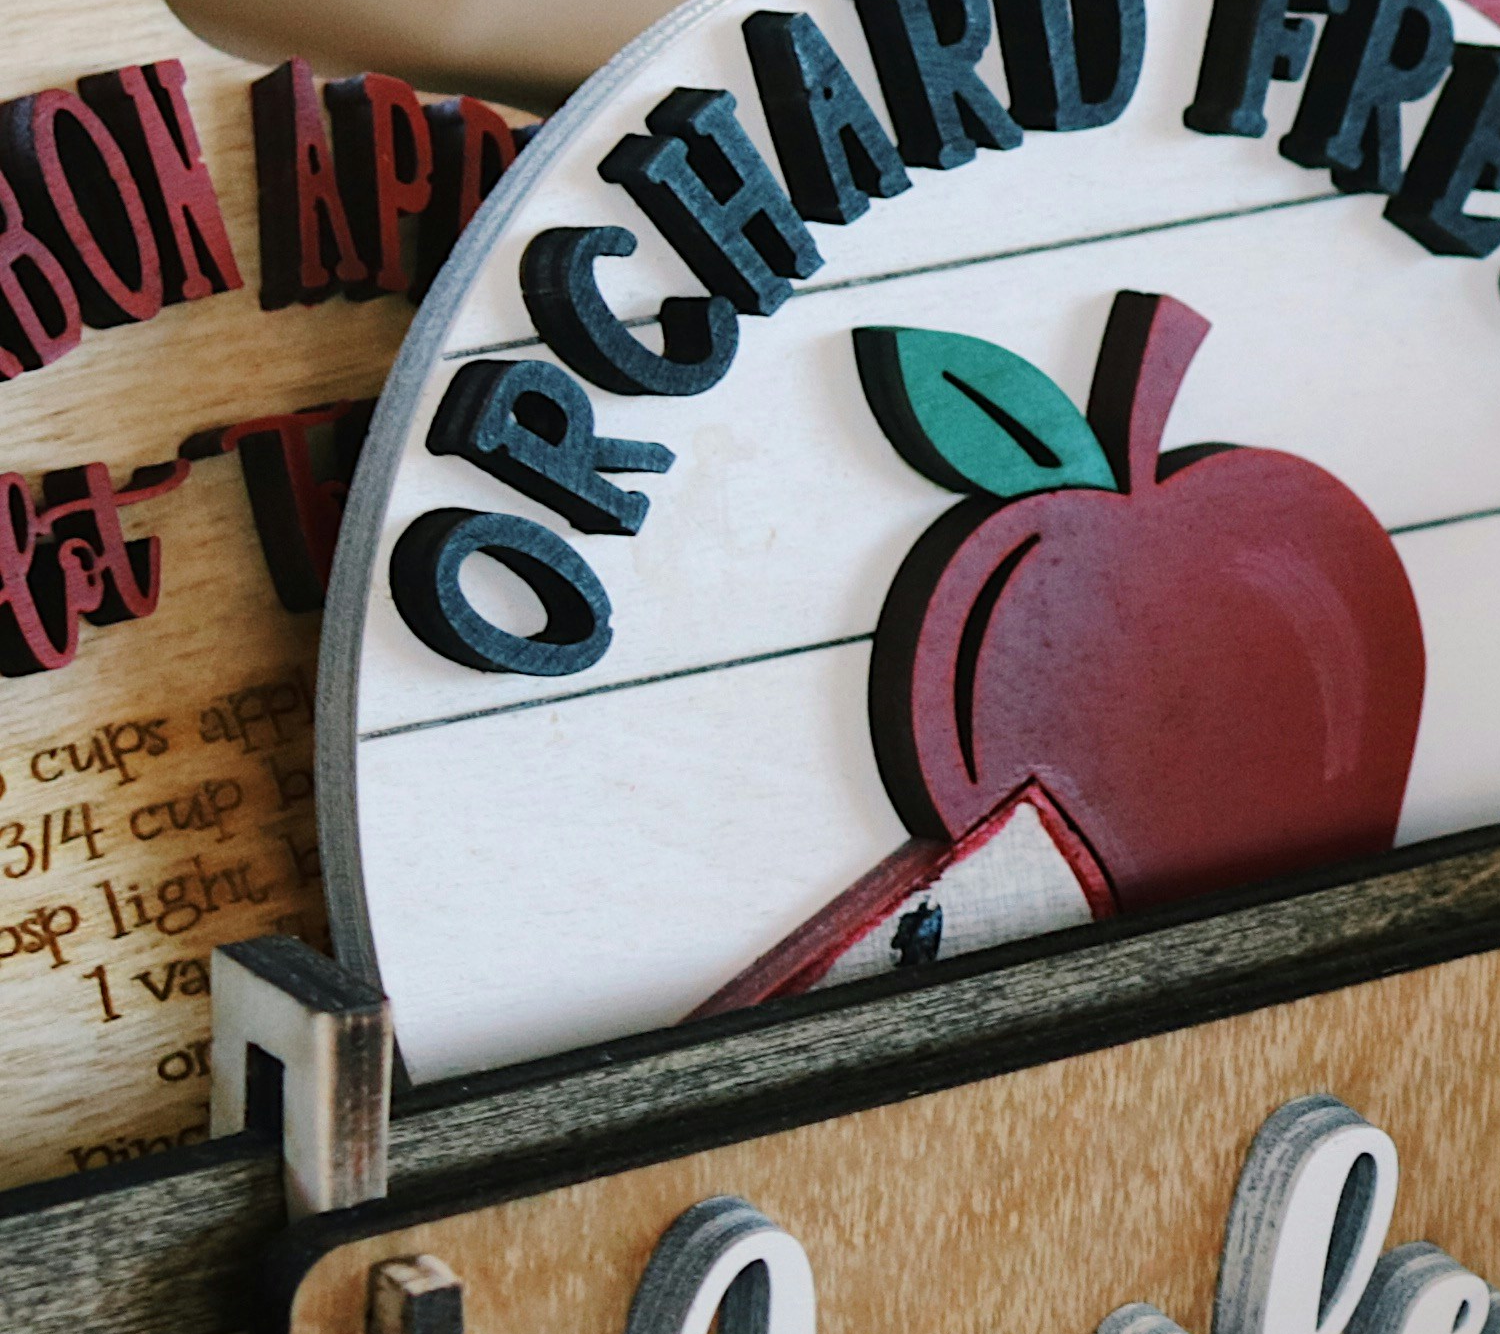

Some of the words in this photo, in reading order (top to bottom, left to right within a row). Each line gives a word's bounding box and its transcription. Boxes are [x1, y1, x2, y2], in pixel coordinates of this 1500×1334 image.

[0, 58, 243, 380] BON
[30, 717, 171, 787] cups
[198, 664, 315, 756] appl
[0, 801, 106, 880] 3/4
[130, 777, 243, 844] cup
[95, 854, 272, 937] light
[132, 957, 211, 1003] va
